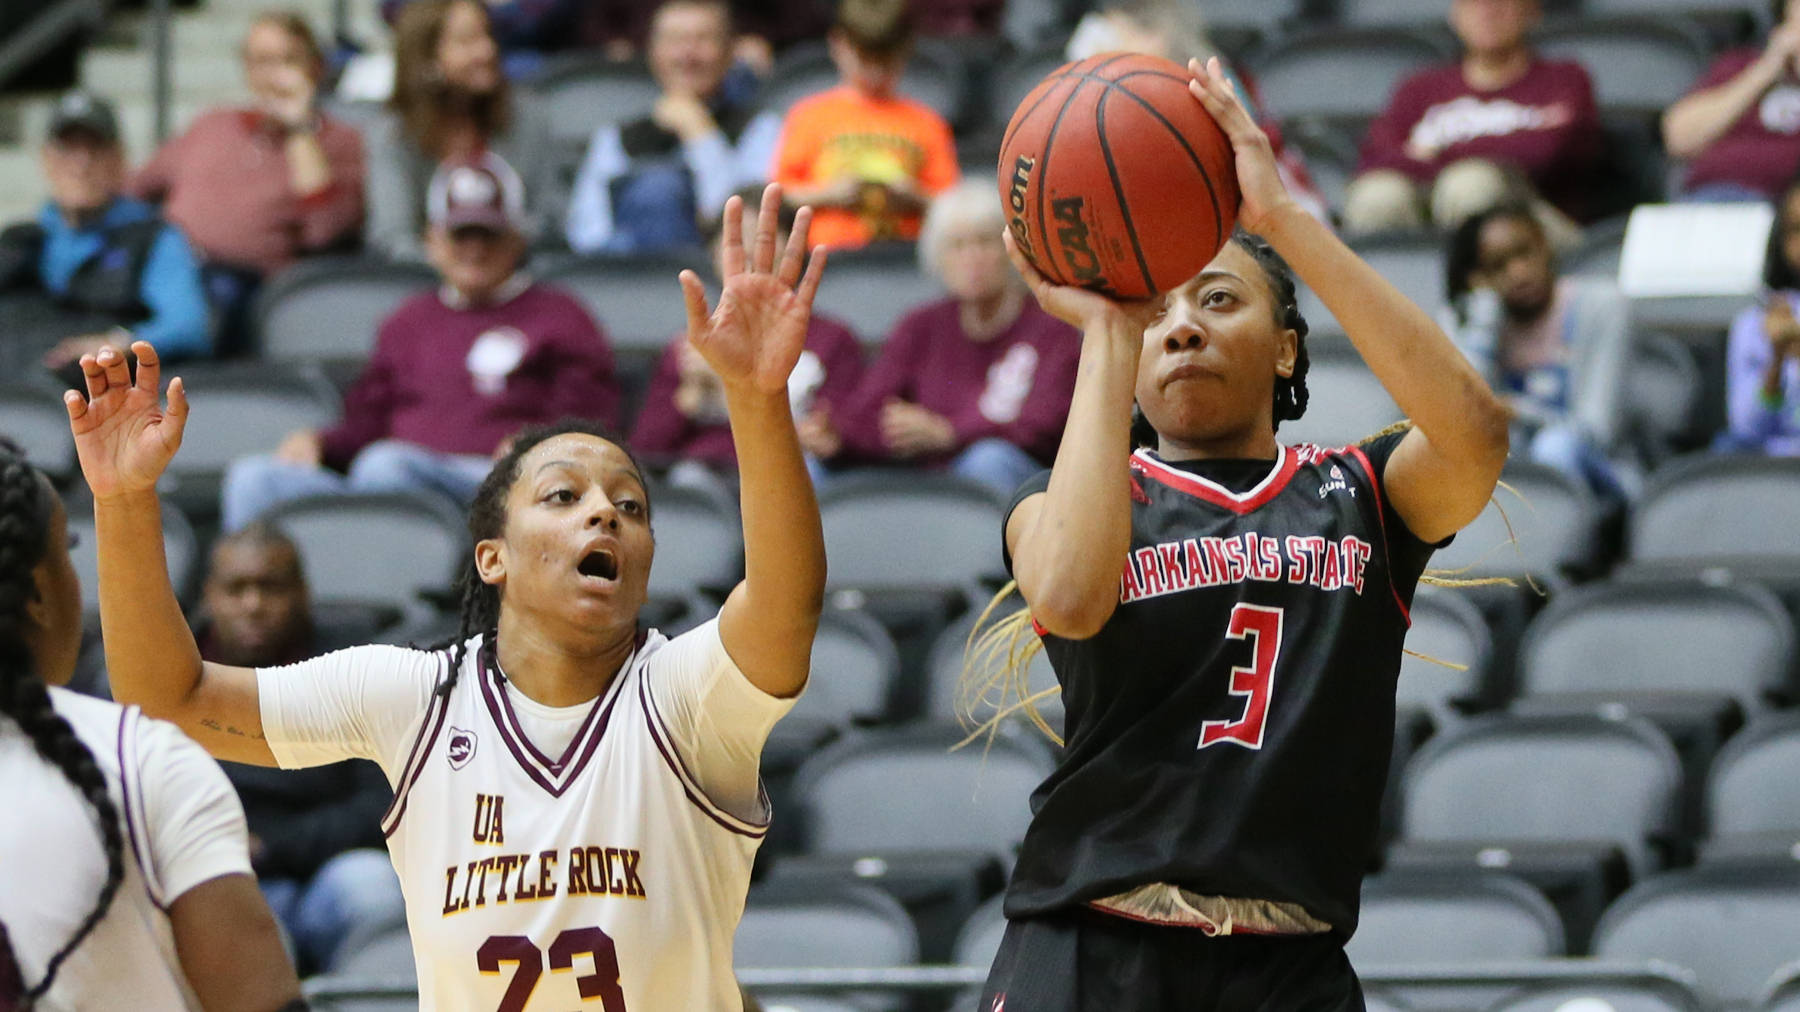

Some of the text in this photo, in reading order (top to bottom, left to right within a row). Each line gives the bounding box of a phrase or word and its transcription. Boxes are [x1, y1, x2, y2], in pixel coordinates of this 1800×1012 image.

[1318, 480, 1347, 499] SUN
[1121, 532, 1371, 604] ARKANSAS STATE
[1197, 602, 1284, 749] 3
[473, 793, 504, 846] UA
[442, 846, 647, 918] LITTLE ROCK
[476, 926, 627, 1012] 23
